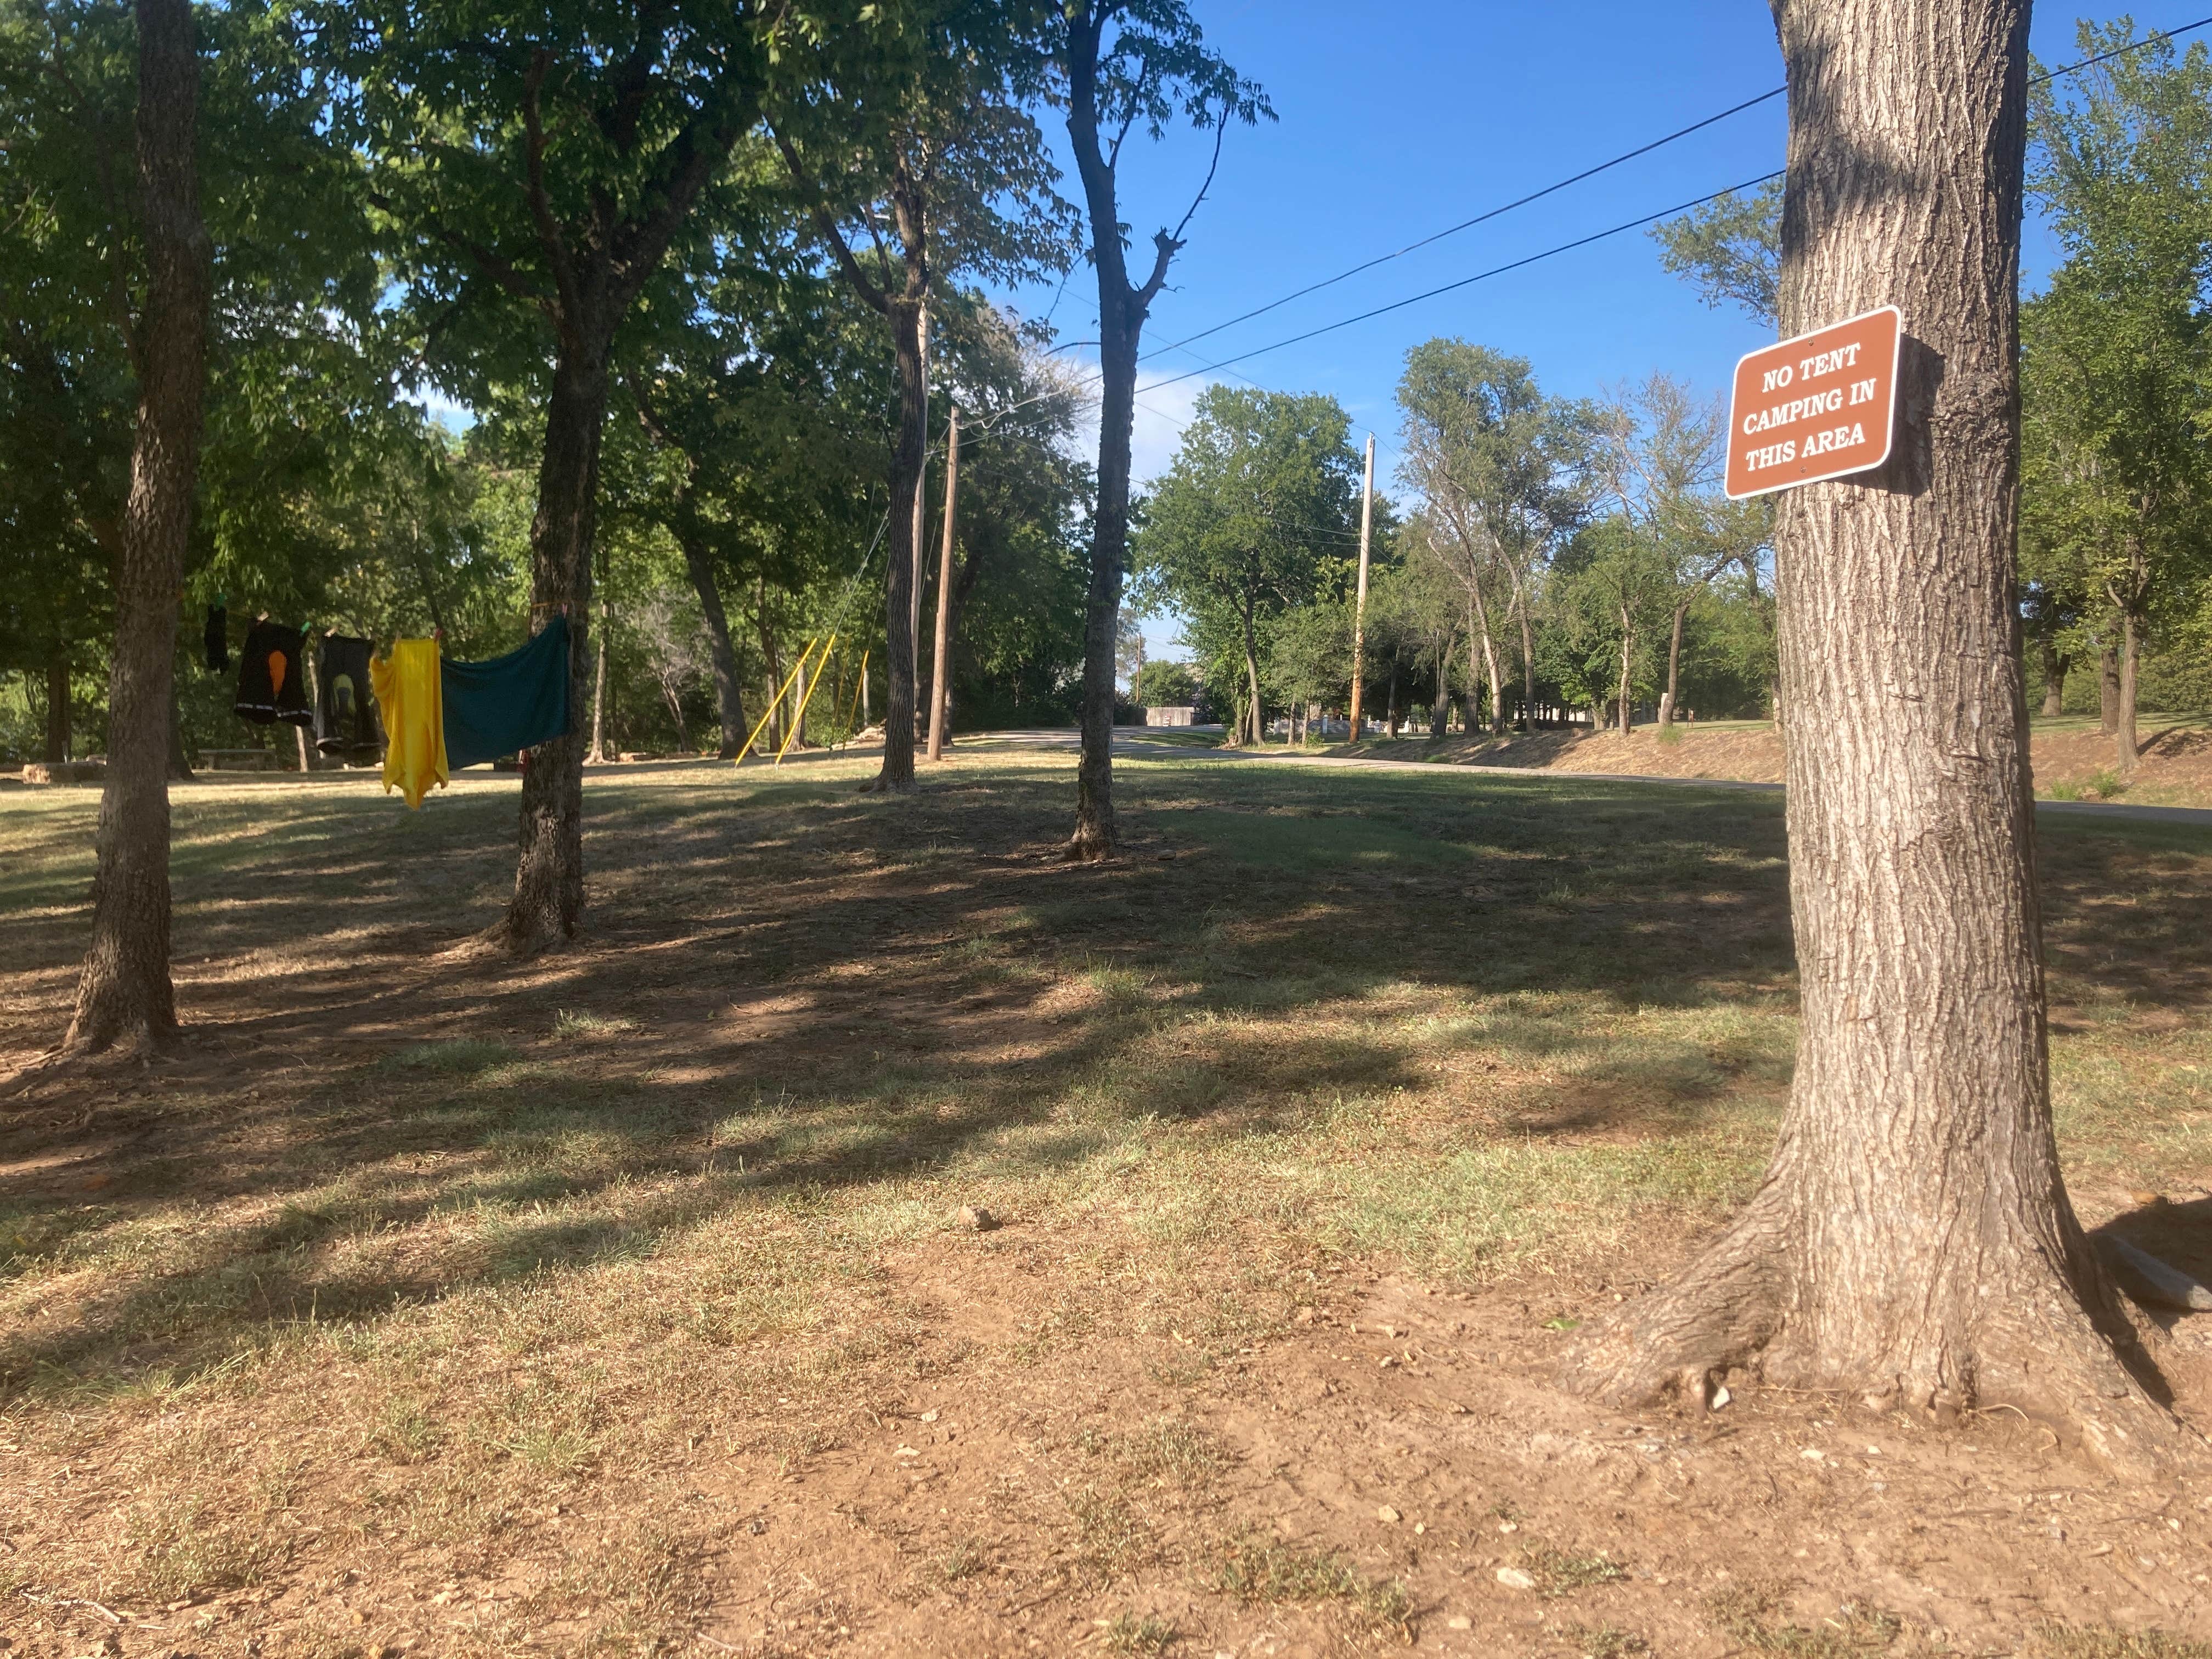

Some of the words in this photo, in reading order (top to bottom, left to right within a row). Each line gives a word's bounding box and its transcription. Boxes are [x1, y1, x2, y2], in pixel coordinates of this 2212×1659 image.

[1762, 365, 1793, 393] NO
[1799, 342, 1861, 381] TENT
[1743, 388, 1843, 435] CAMPING
[1849, 377, 1877, 406] IN
[1746, 440, 1796, 472] THIS
[1801, 422, 1866, 458] AREA
